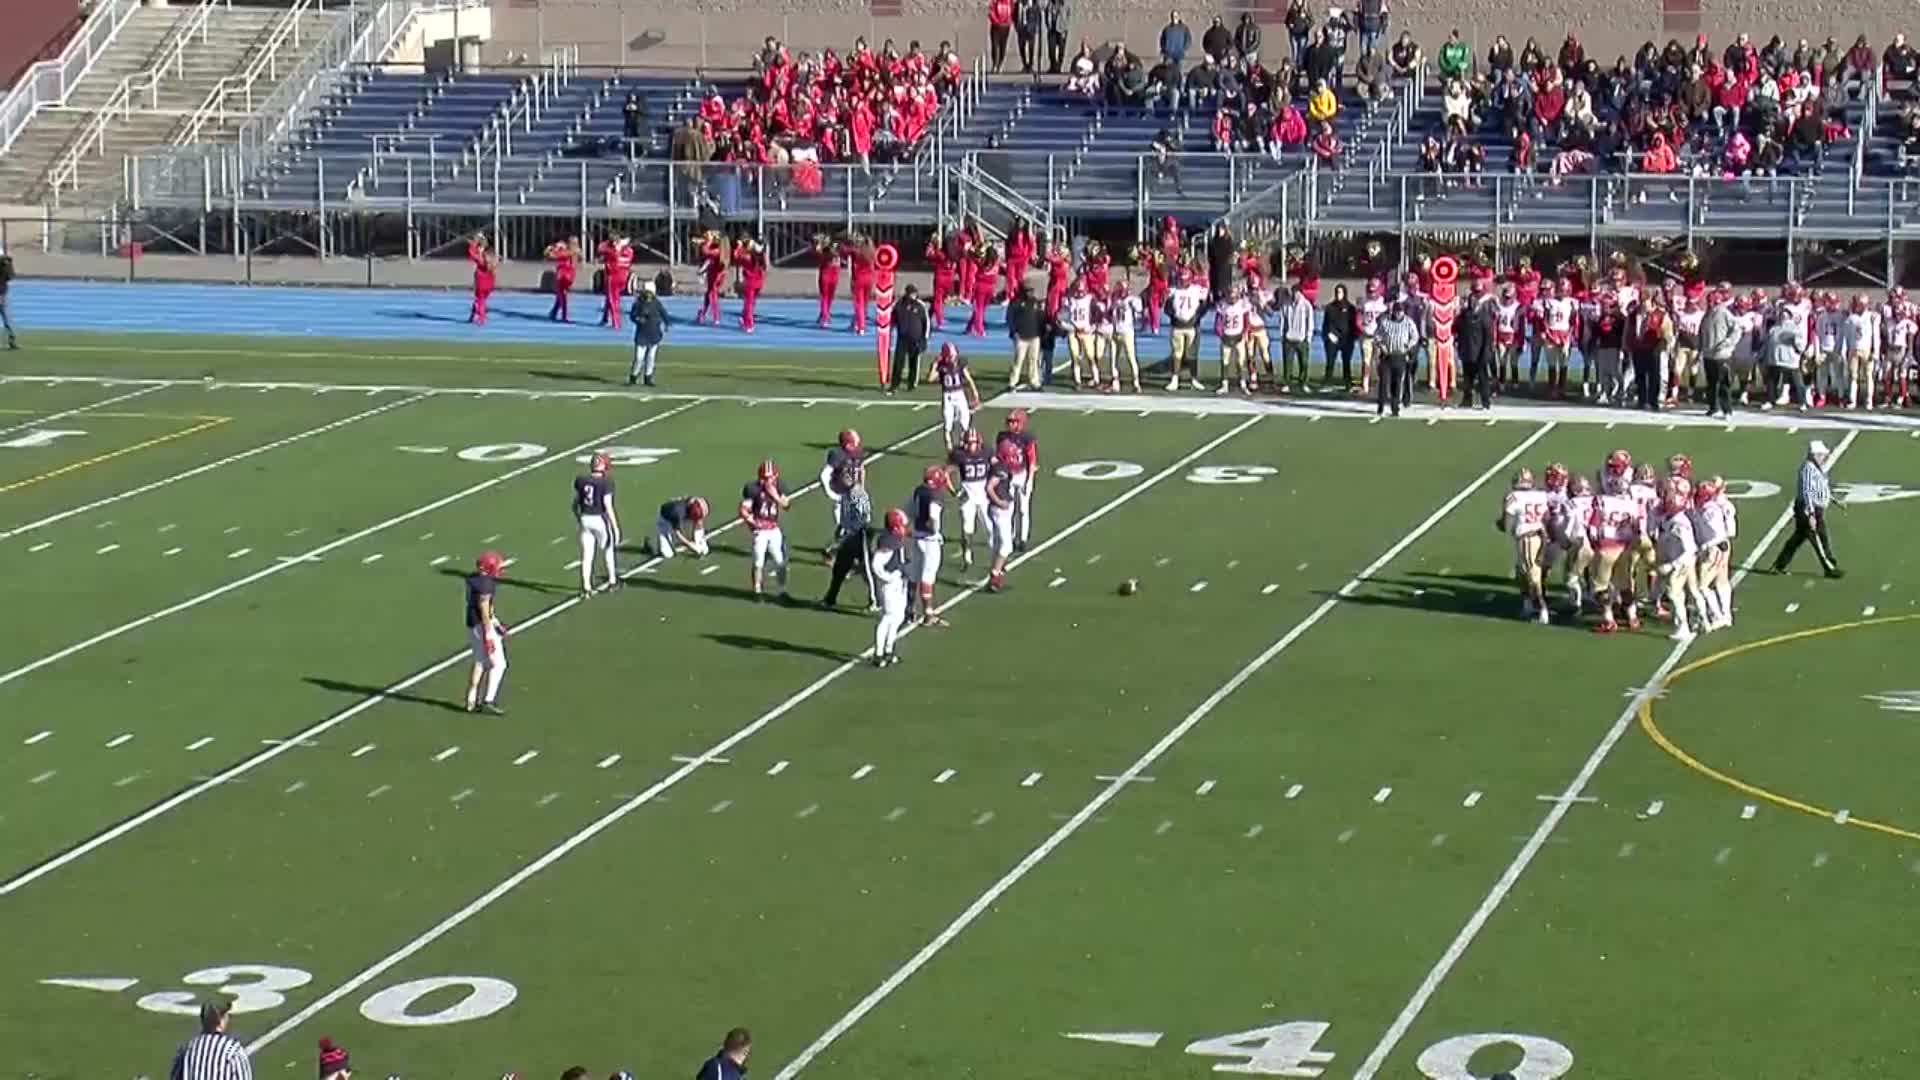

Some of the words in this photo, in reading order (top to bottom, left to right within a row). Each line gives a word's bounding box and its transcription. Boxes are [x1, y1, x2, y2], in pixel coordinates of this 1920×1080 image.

[1179, 296, 1193, 310] 71
[583, 484, 595, 506] 3
[1524, 502, 1543, 525] 55
